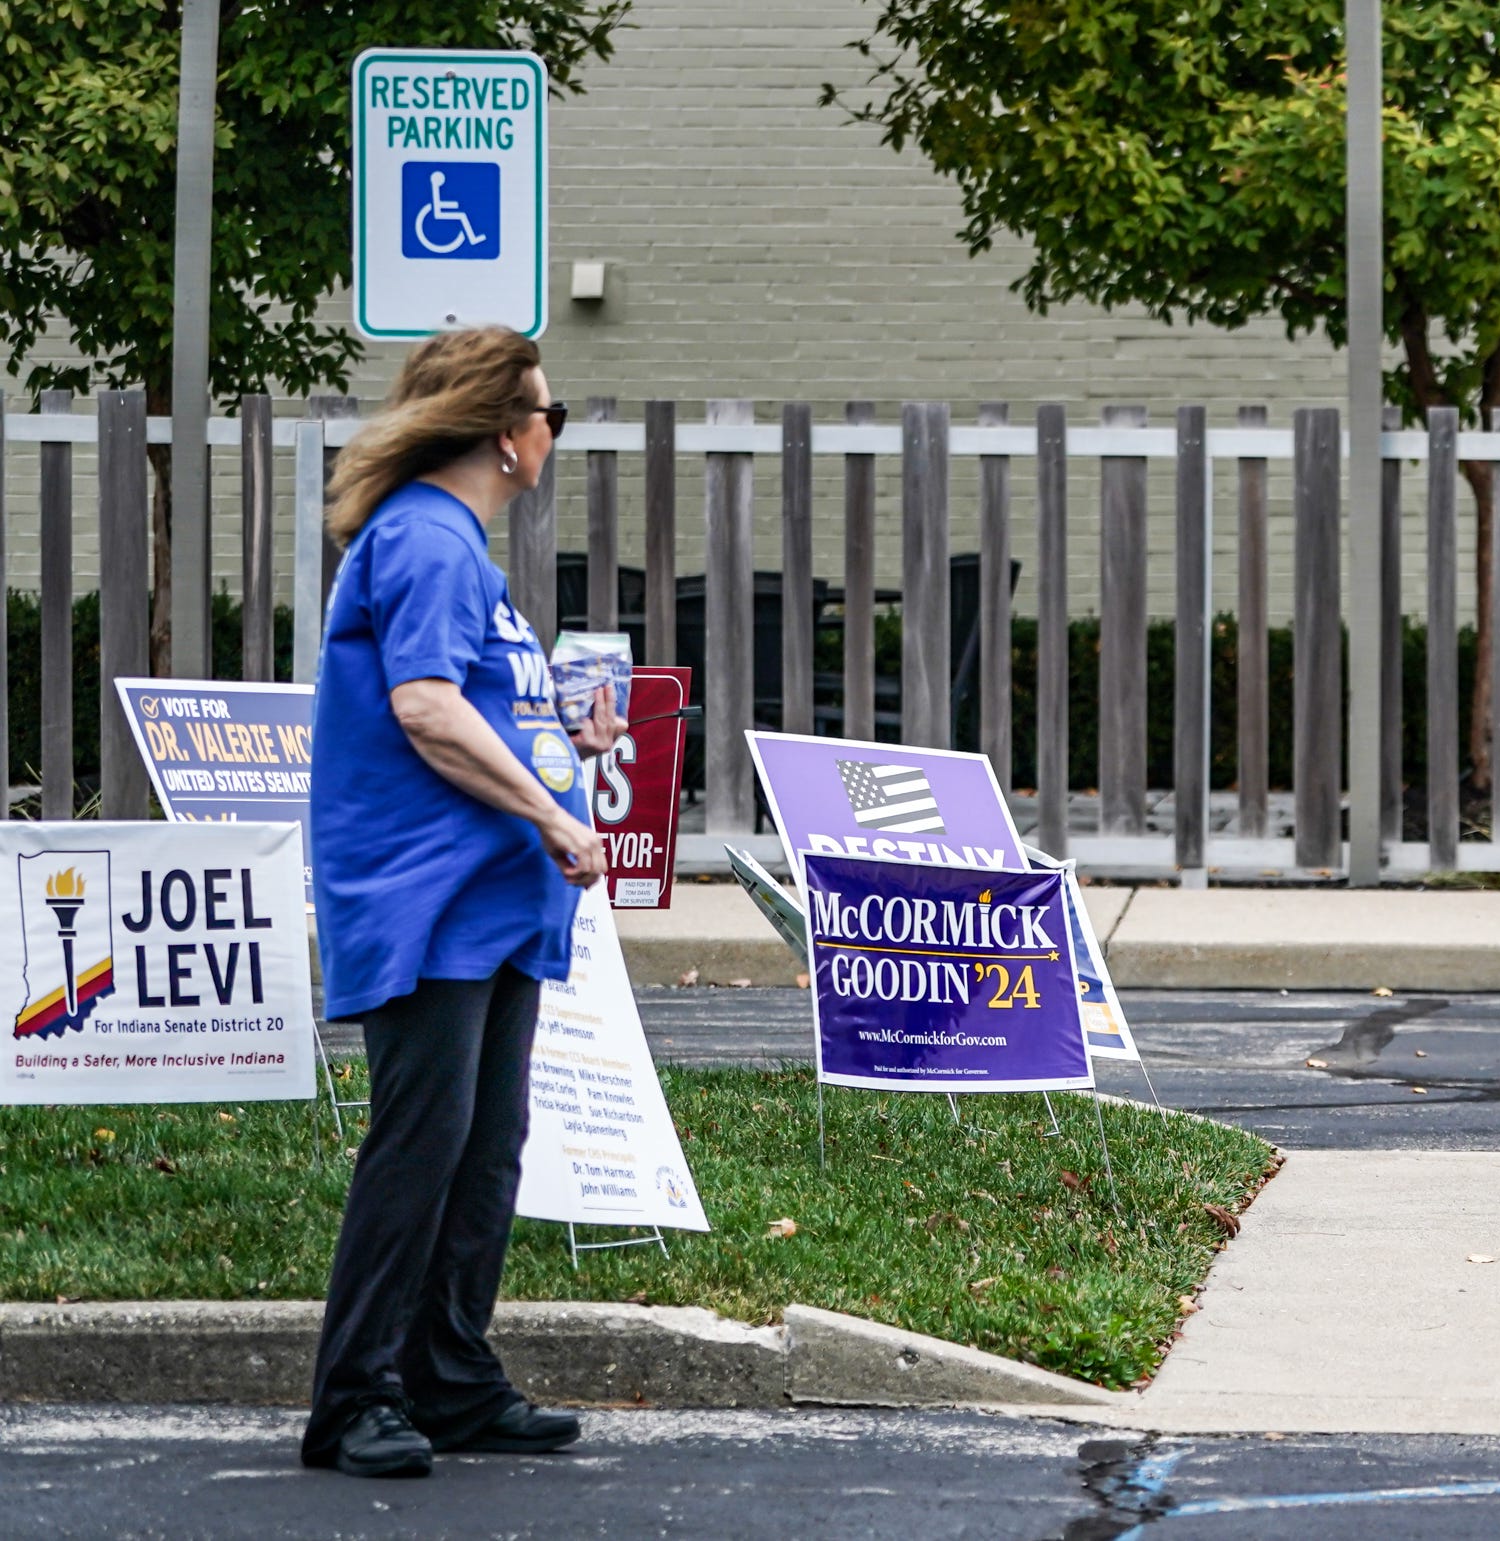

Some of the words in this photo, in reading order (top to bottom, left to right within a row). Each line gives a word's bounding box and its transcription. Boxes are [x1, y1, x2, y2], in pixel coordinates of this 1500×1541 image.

[371, 76, 530, 110] RESERVED
[388, 116, 514, 150] PARKING
[162, 697, 200, 718] VOTE
[201, 699, 231, 719] FOR
[144, 721, 190, 762] DR.
[186, 722, 280, 764] VALERIE
[277, 725, 313, 765] MC
[162, 769, 215, 792] UNITED
[215, 770, 266, 793] STATES
[122, 868, 272, 933] JOEL
[811, 887, 1058, 949] McCORMICK
[135, 942, 264, 1008] LEVI
[831, 954, 970, 1004] GOODIN
[975, 963, 1041, 1009] '24
[95, 1020, 113, 1034] For
[117, 1019, 160, 1034] Indiana
[165, 1019, 207, 1033] Senate
[211, 1018, 261, 1033] District
[267, 1018, 284, 1032] 20
[859, 1028, 1007, 1047] www.McCormickforGov.com
[16, 1054, 67, 1070] Building
[71, 1058, 79, 1068] a
[84, 1054, 120, 1069] Safer,
[125, 1055, 157, 1067] More
[162, 1054, 225, 1067] Inclusive
[231, 1052, 285, 1066] Indiana
[585, 1163, 602, 1175] Tom
[604, 1165, 635, 1179] Harmas
[581, 1182, 600, 1198] John
[601, 1184, 637, 1198] Williams
